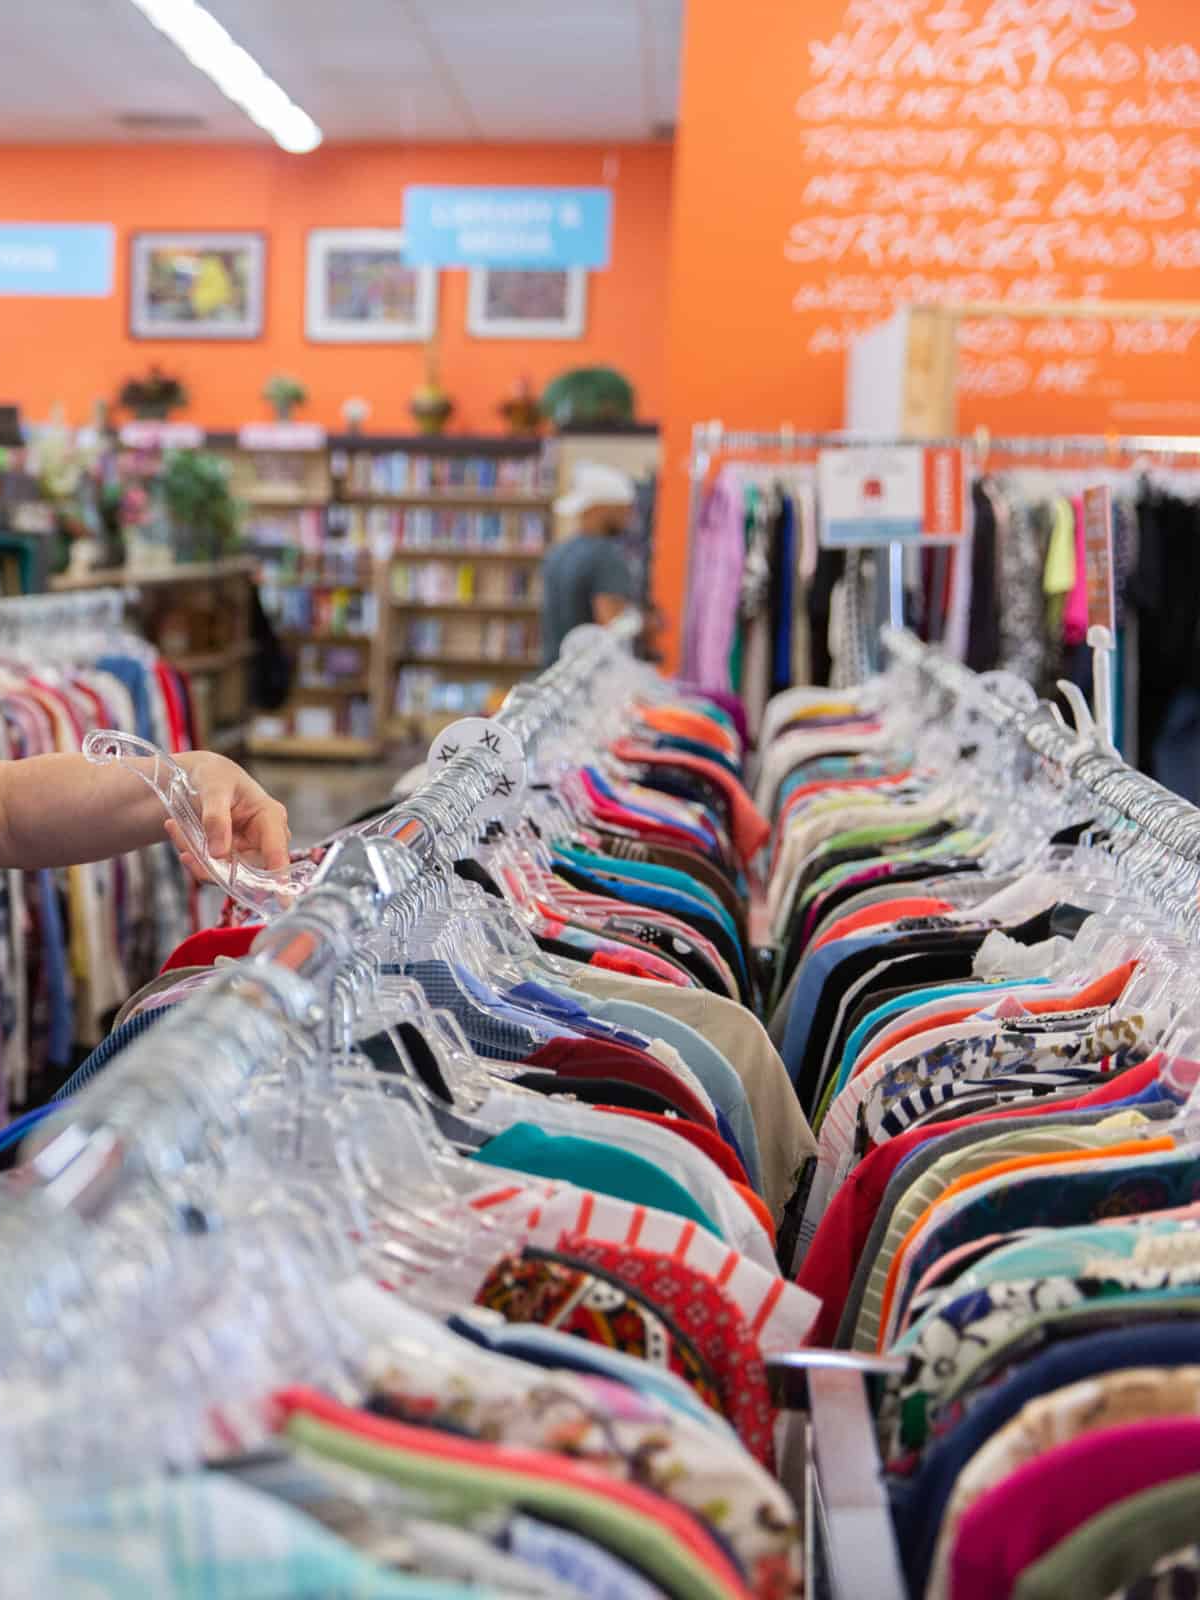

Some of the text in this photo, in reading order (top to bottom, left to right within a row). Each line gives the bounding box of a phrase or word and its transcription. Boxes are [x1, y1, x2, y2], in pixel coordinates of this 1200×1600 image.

[437, 744, 460, 762] XL
[480, 729, 501, 754] XL
[492, 774, 517, 797] XL
